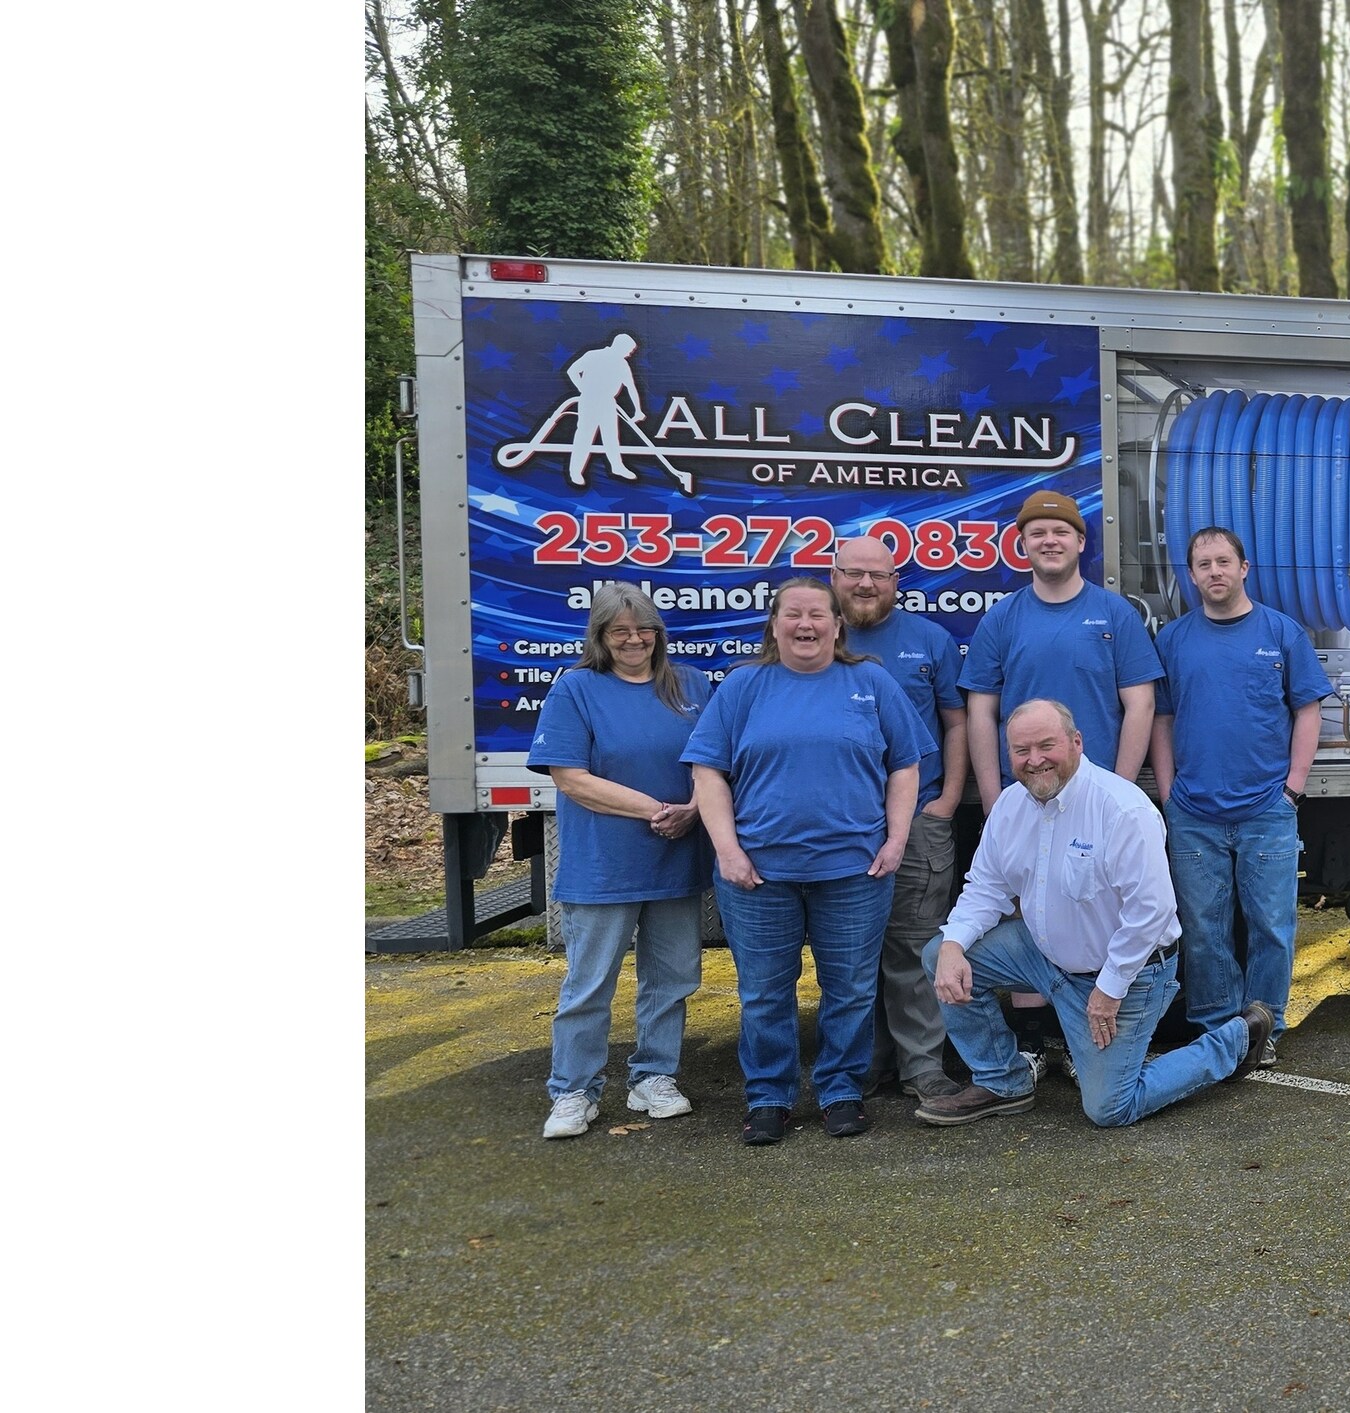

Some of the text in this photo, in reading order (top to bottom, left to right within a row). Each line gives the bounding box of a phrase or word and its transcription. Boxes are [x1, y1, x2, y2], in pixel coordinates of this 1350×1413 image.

[654, 396, 1051, 452] ALL CLEAN
[752, 462, 963, 488] OF AMERICA
[514, 640, 584, 657] Carpet
[666, 640, 717, 657] stery
